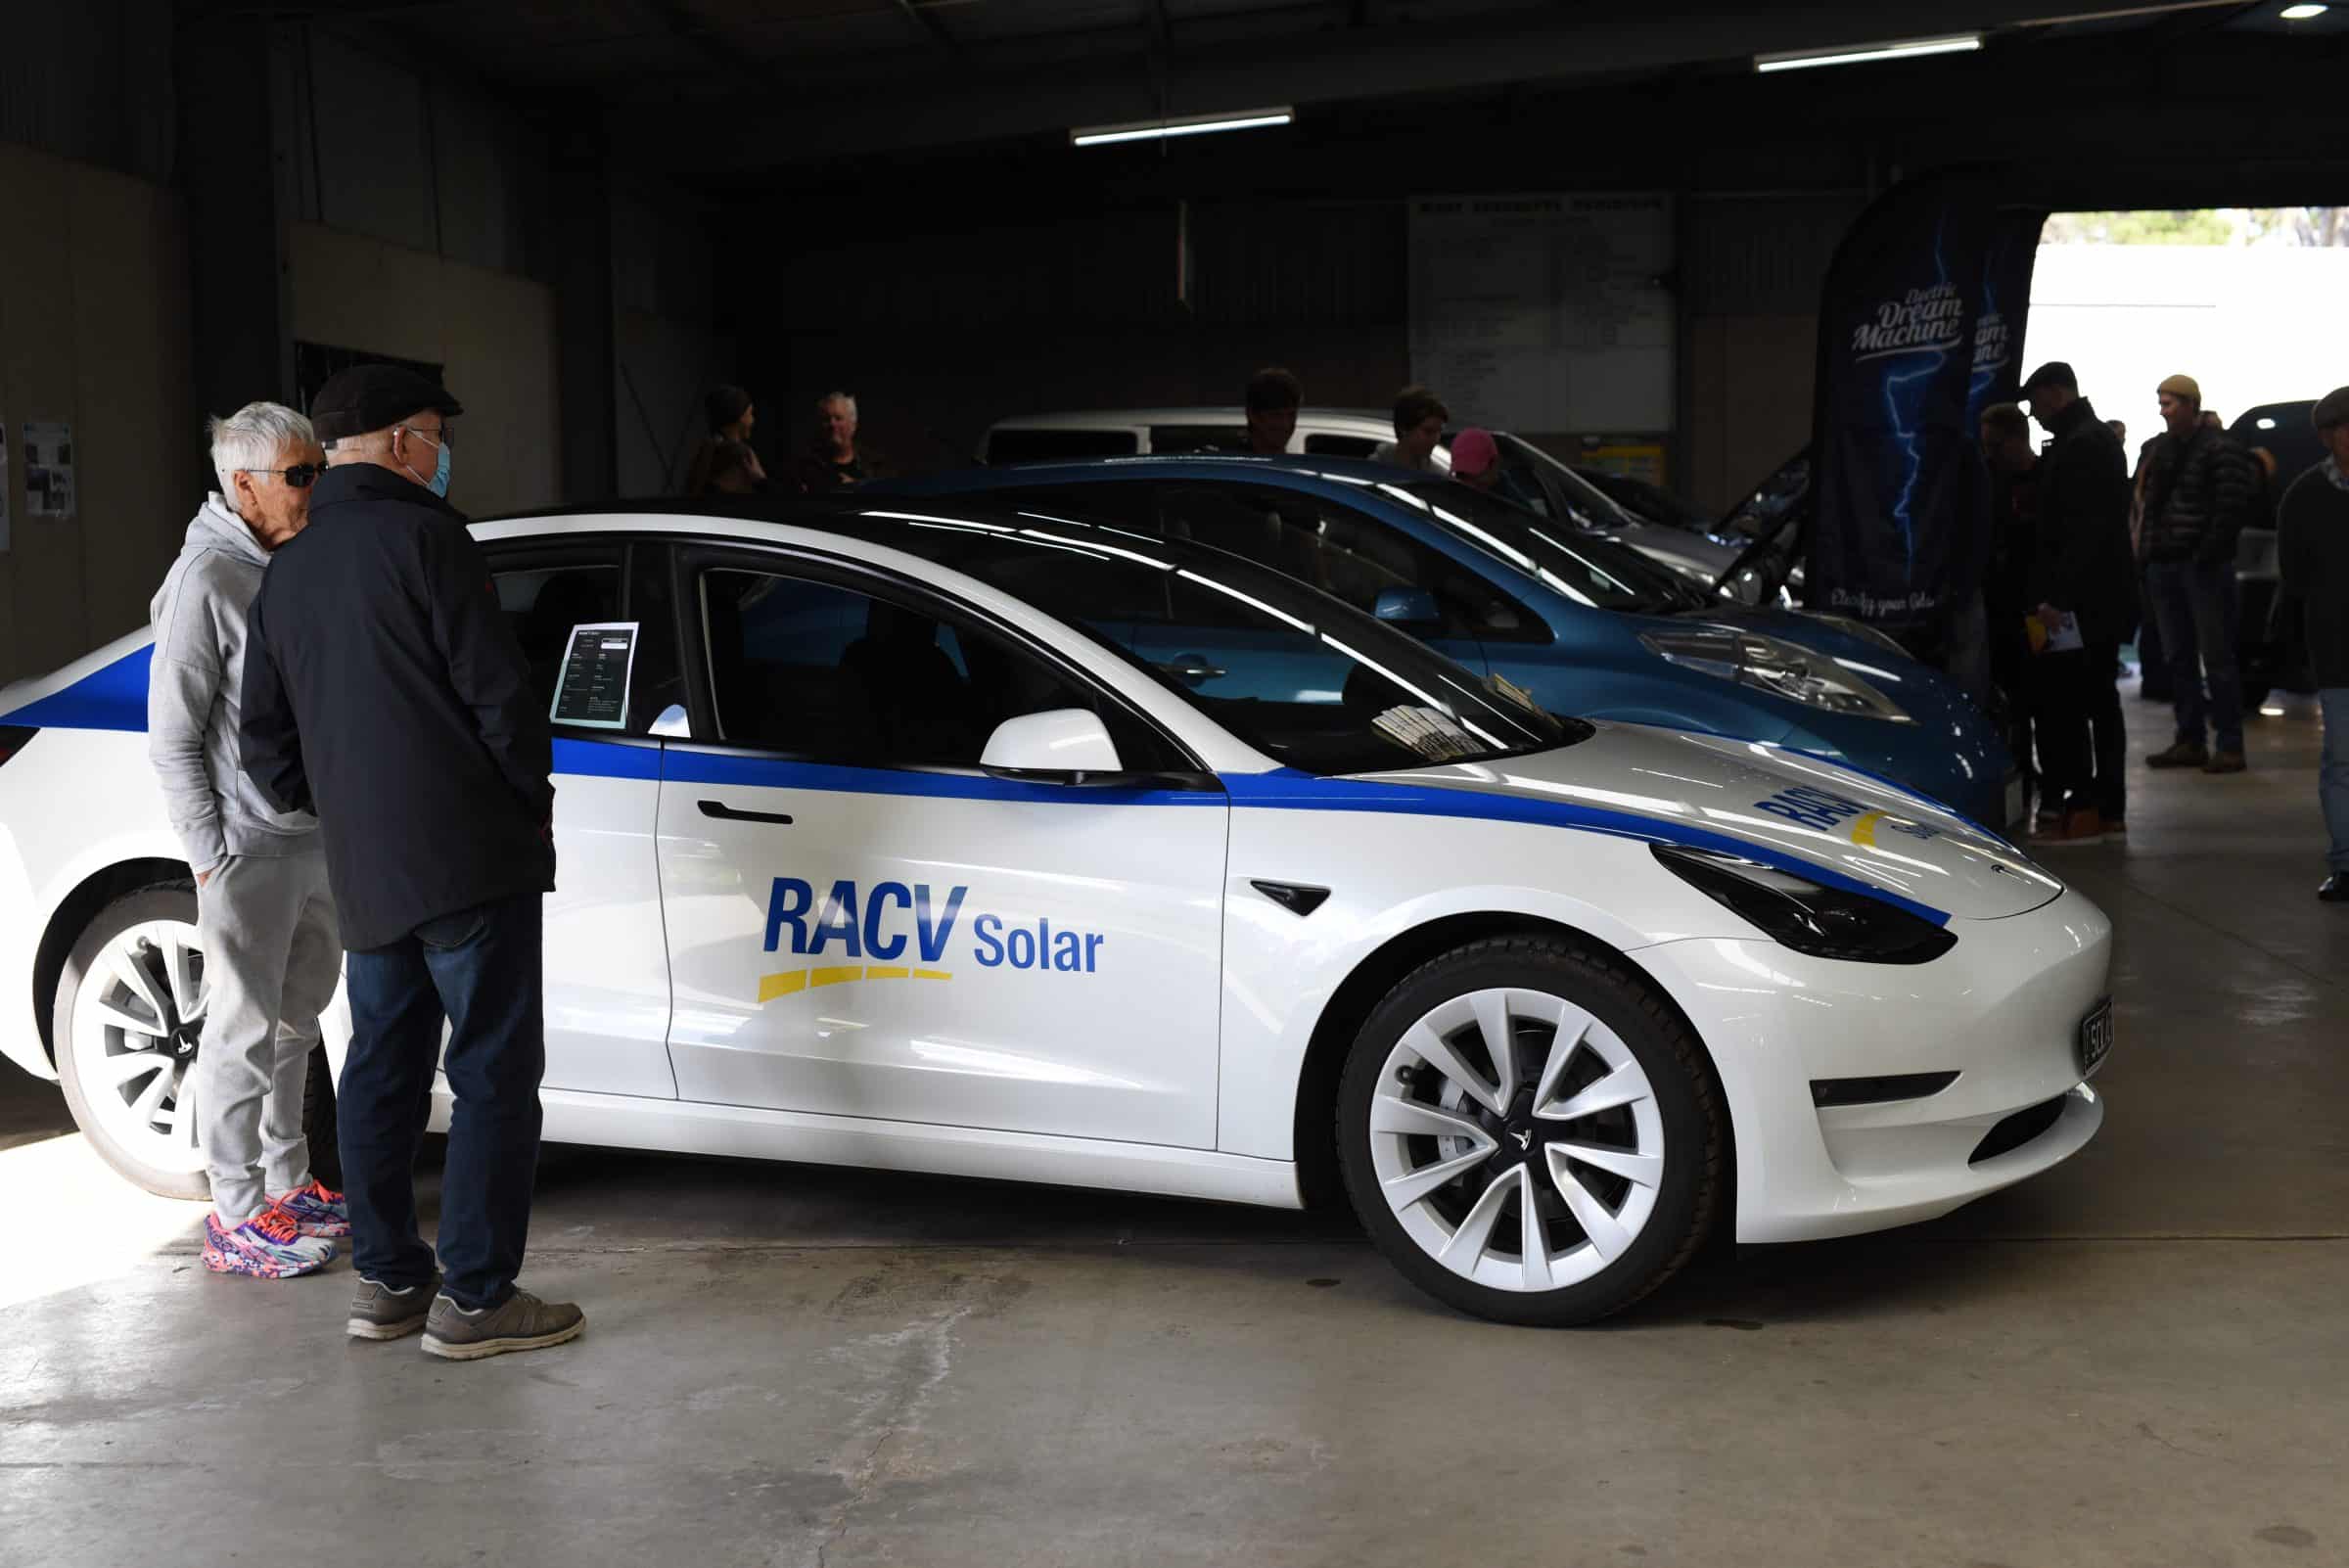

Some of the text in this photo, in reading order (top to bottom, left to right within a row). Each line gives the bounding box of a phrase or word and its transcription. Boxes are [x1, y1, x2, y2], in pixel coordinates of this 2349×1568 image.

[1876, 297, 1963, 330] Dream
[1850, 317, 1961, 352] Machine
[763, 877, 1104, 973] RACV Solar
